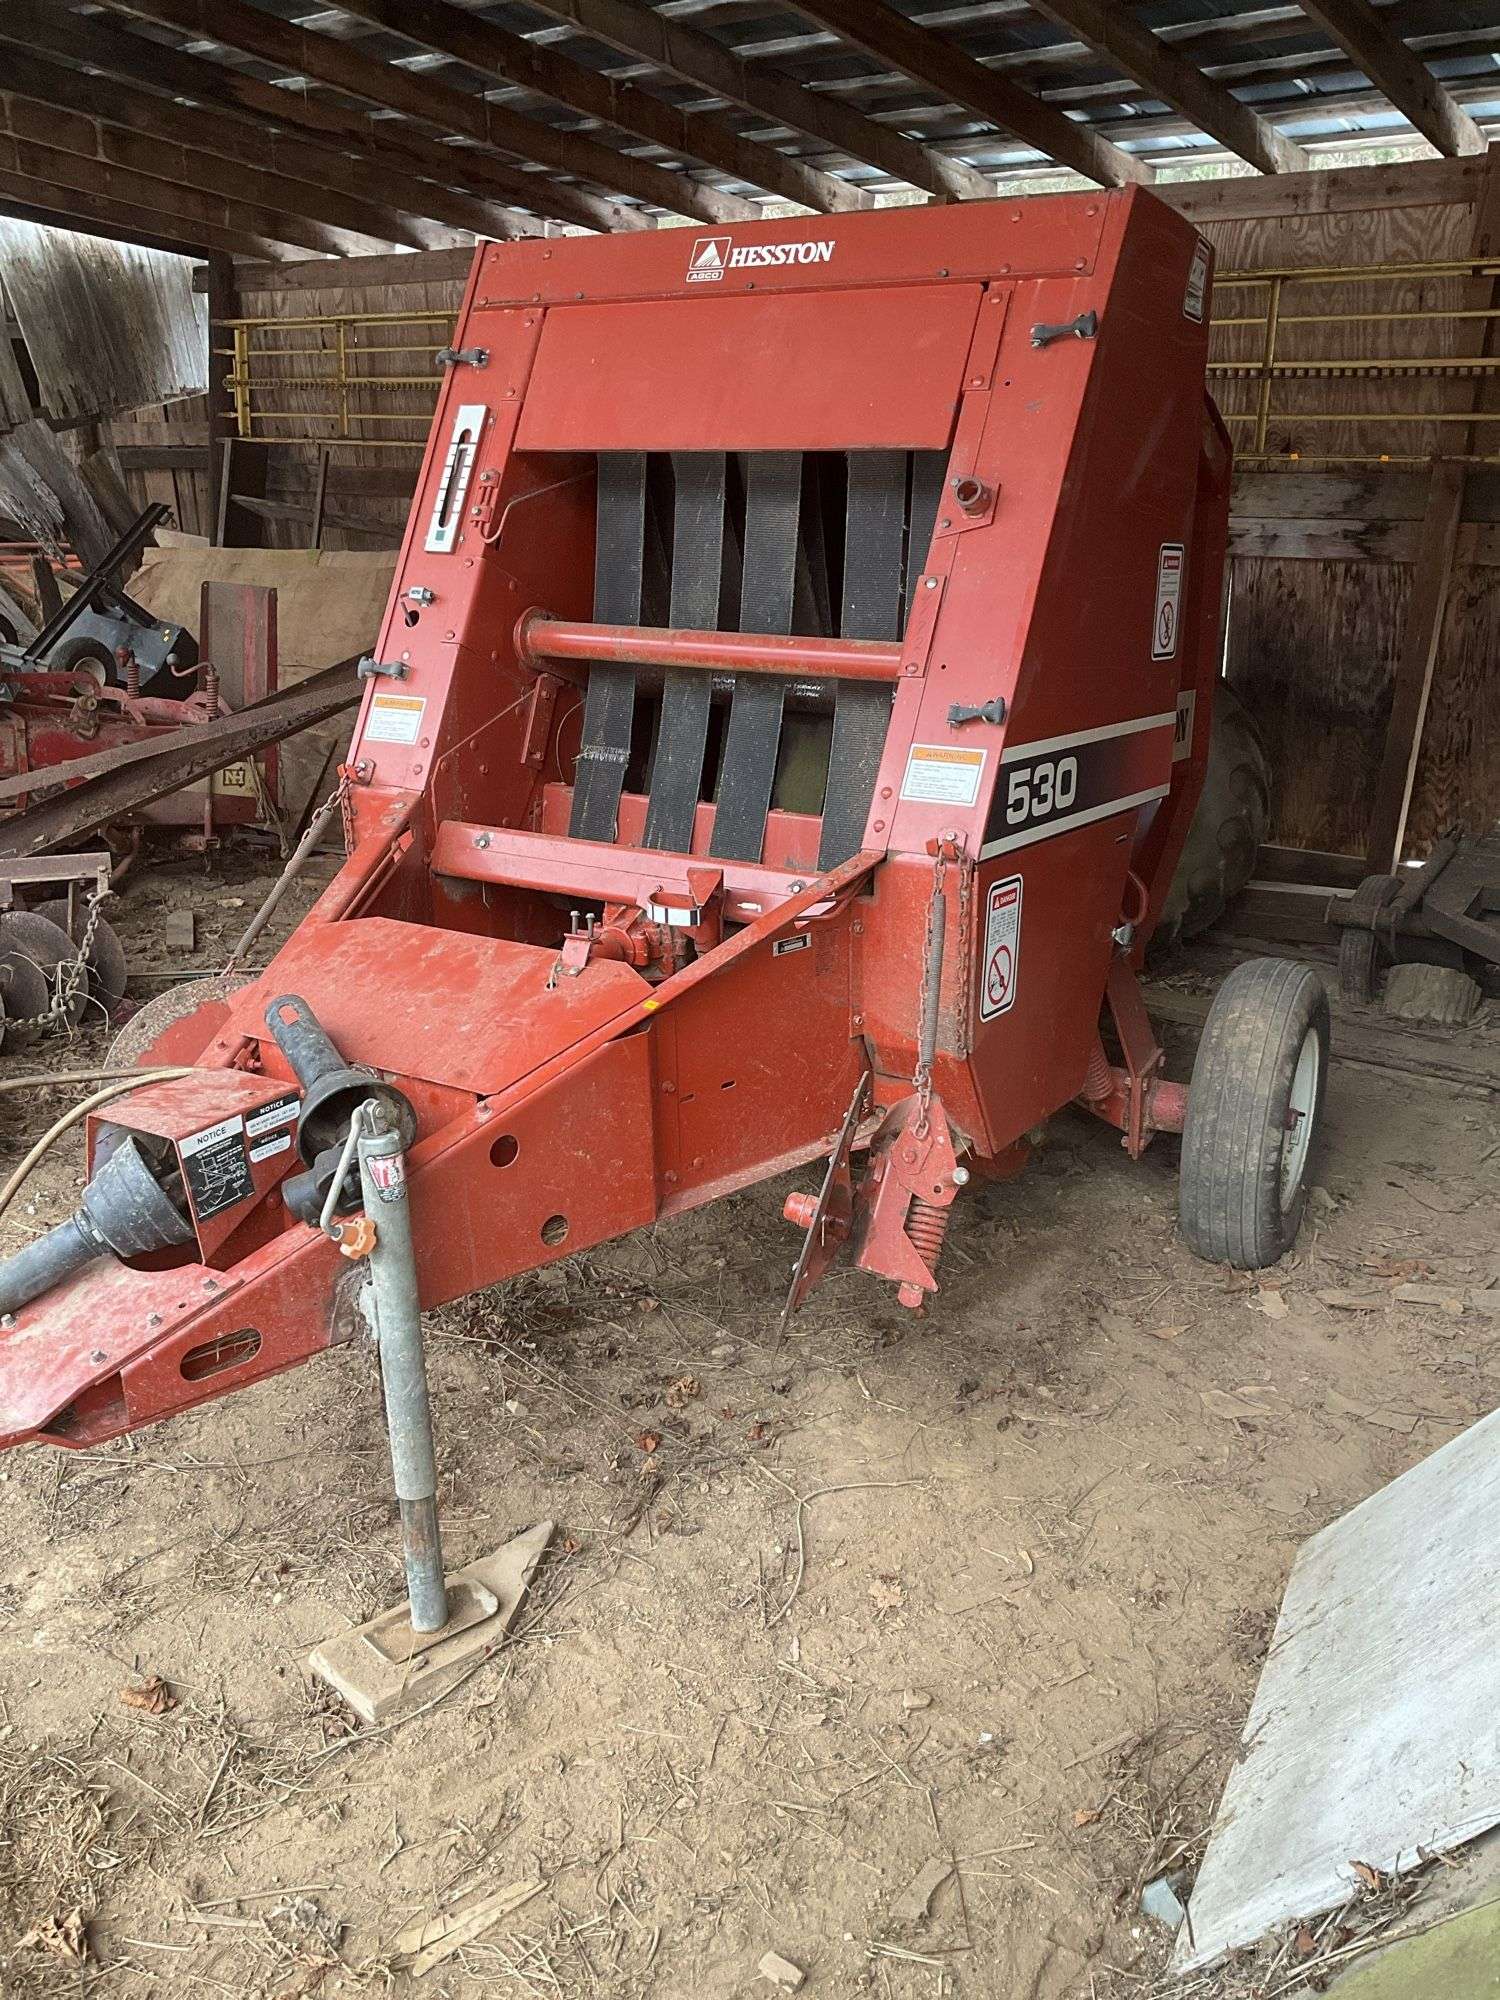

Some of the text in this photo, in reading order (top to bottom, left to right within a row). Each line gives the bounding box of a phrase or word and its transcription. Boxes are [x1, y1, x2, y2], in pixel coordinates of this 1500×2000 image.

[728, 240, 835, 268] HESSTON
[690, 272, 720, 280] AGCO
[1006, 756, 1078, 825] 530
[260, 1100, 284, 1115] NOTICE
[197, 1126, 227, 1145] NOTICE
